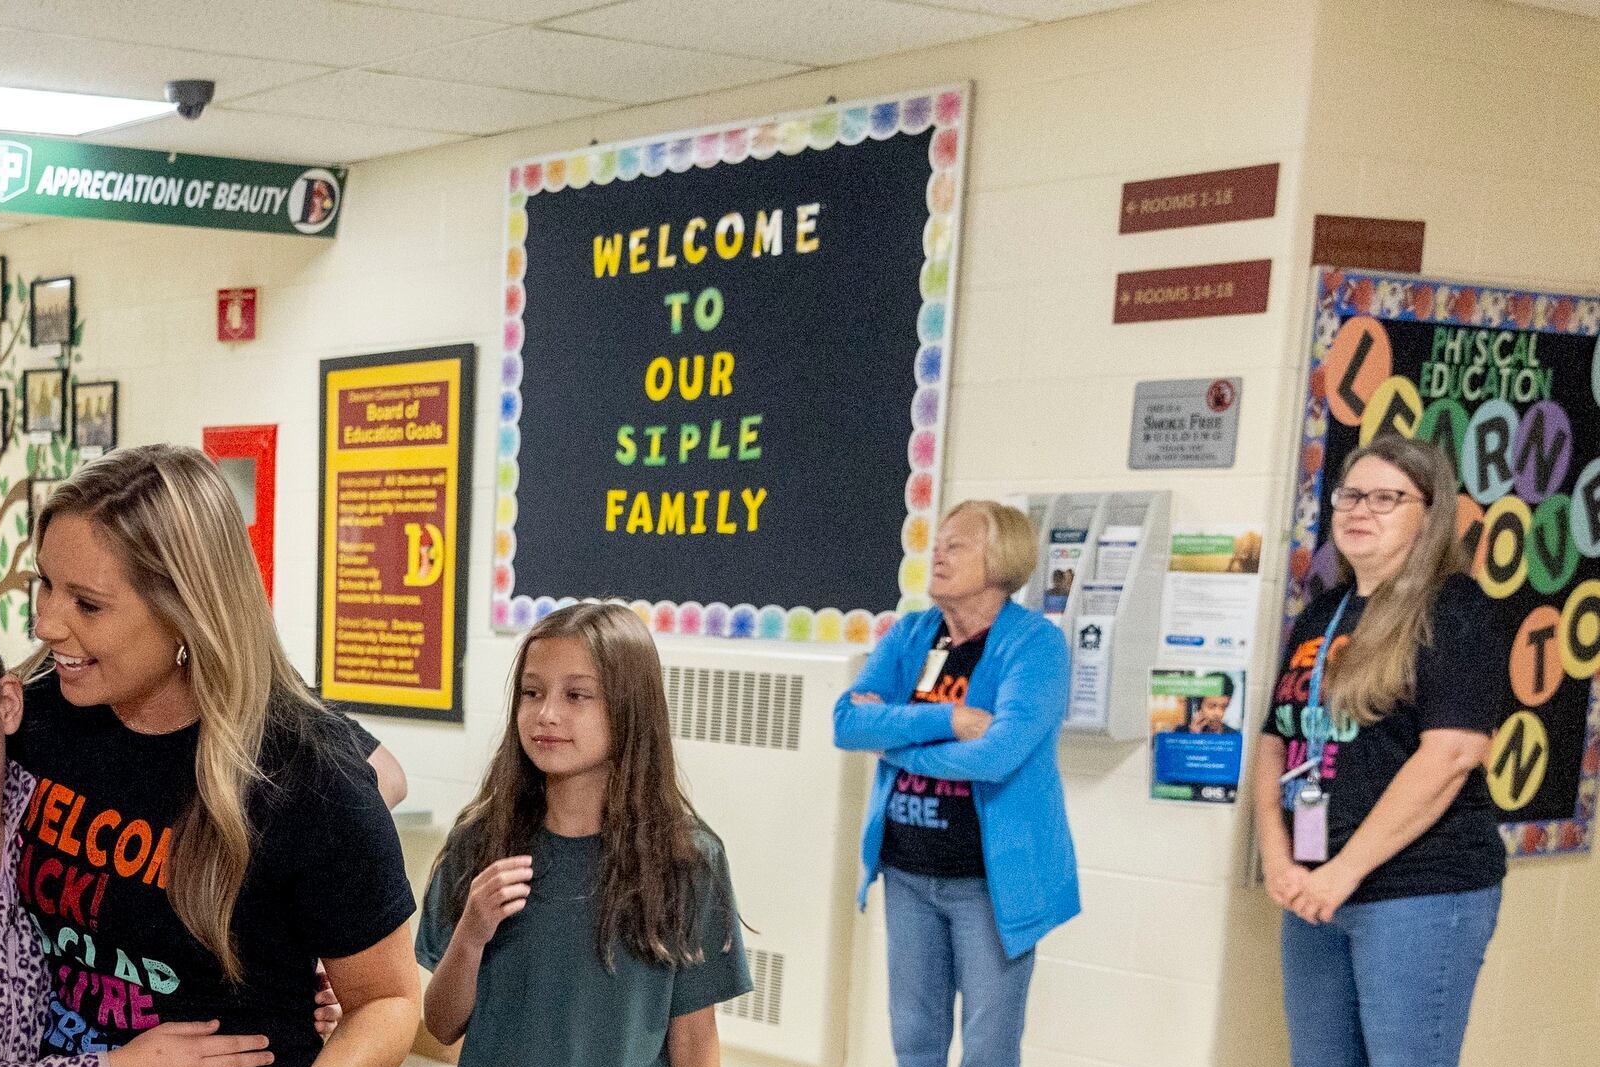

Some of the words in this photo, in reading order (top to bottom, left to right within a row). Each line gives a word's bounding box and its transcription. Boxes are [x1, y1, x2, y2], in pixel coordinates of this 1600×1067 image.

[36, 165, 183, 206] APPRECIATION
[183, 179, 213, 209] OF
[215, 184, 288, 215] BEAUTY
[1140, 193, 1195, 214] ROOMS
[593, 203, 821, 279] WELCOME
[664, 287, 724, 334] TO
[1134, 286, 1189, 305] ROOMS
[645, 351, 735, 402] OUR
[344, 425, 404, 444] Education
[405, 421, 443, 441] Goals
[366, 402, 404, 422] Board
[405, 400, 420, 419] of
[615, 415, 764, 466] SIPLE
[605, 488, 768, 536] FAMILY
